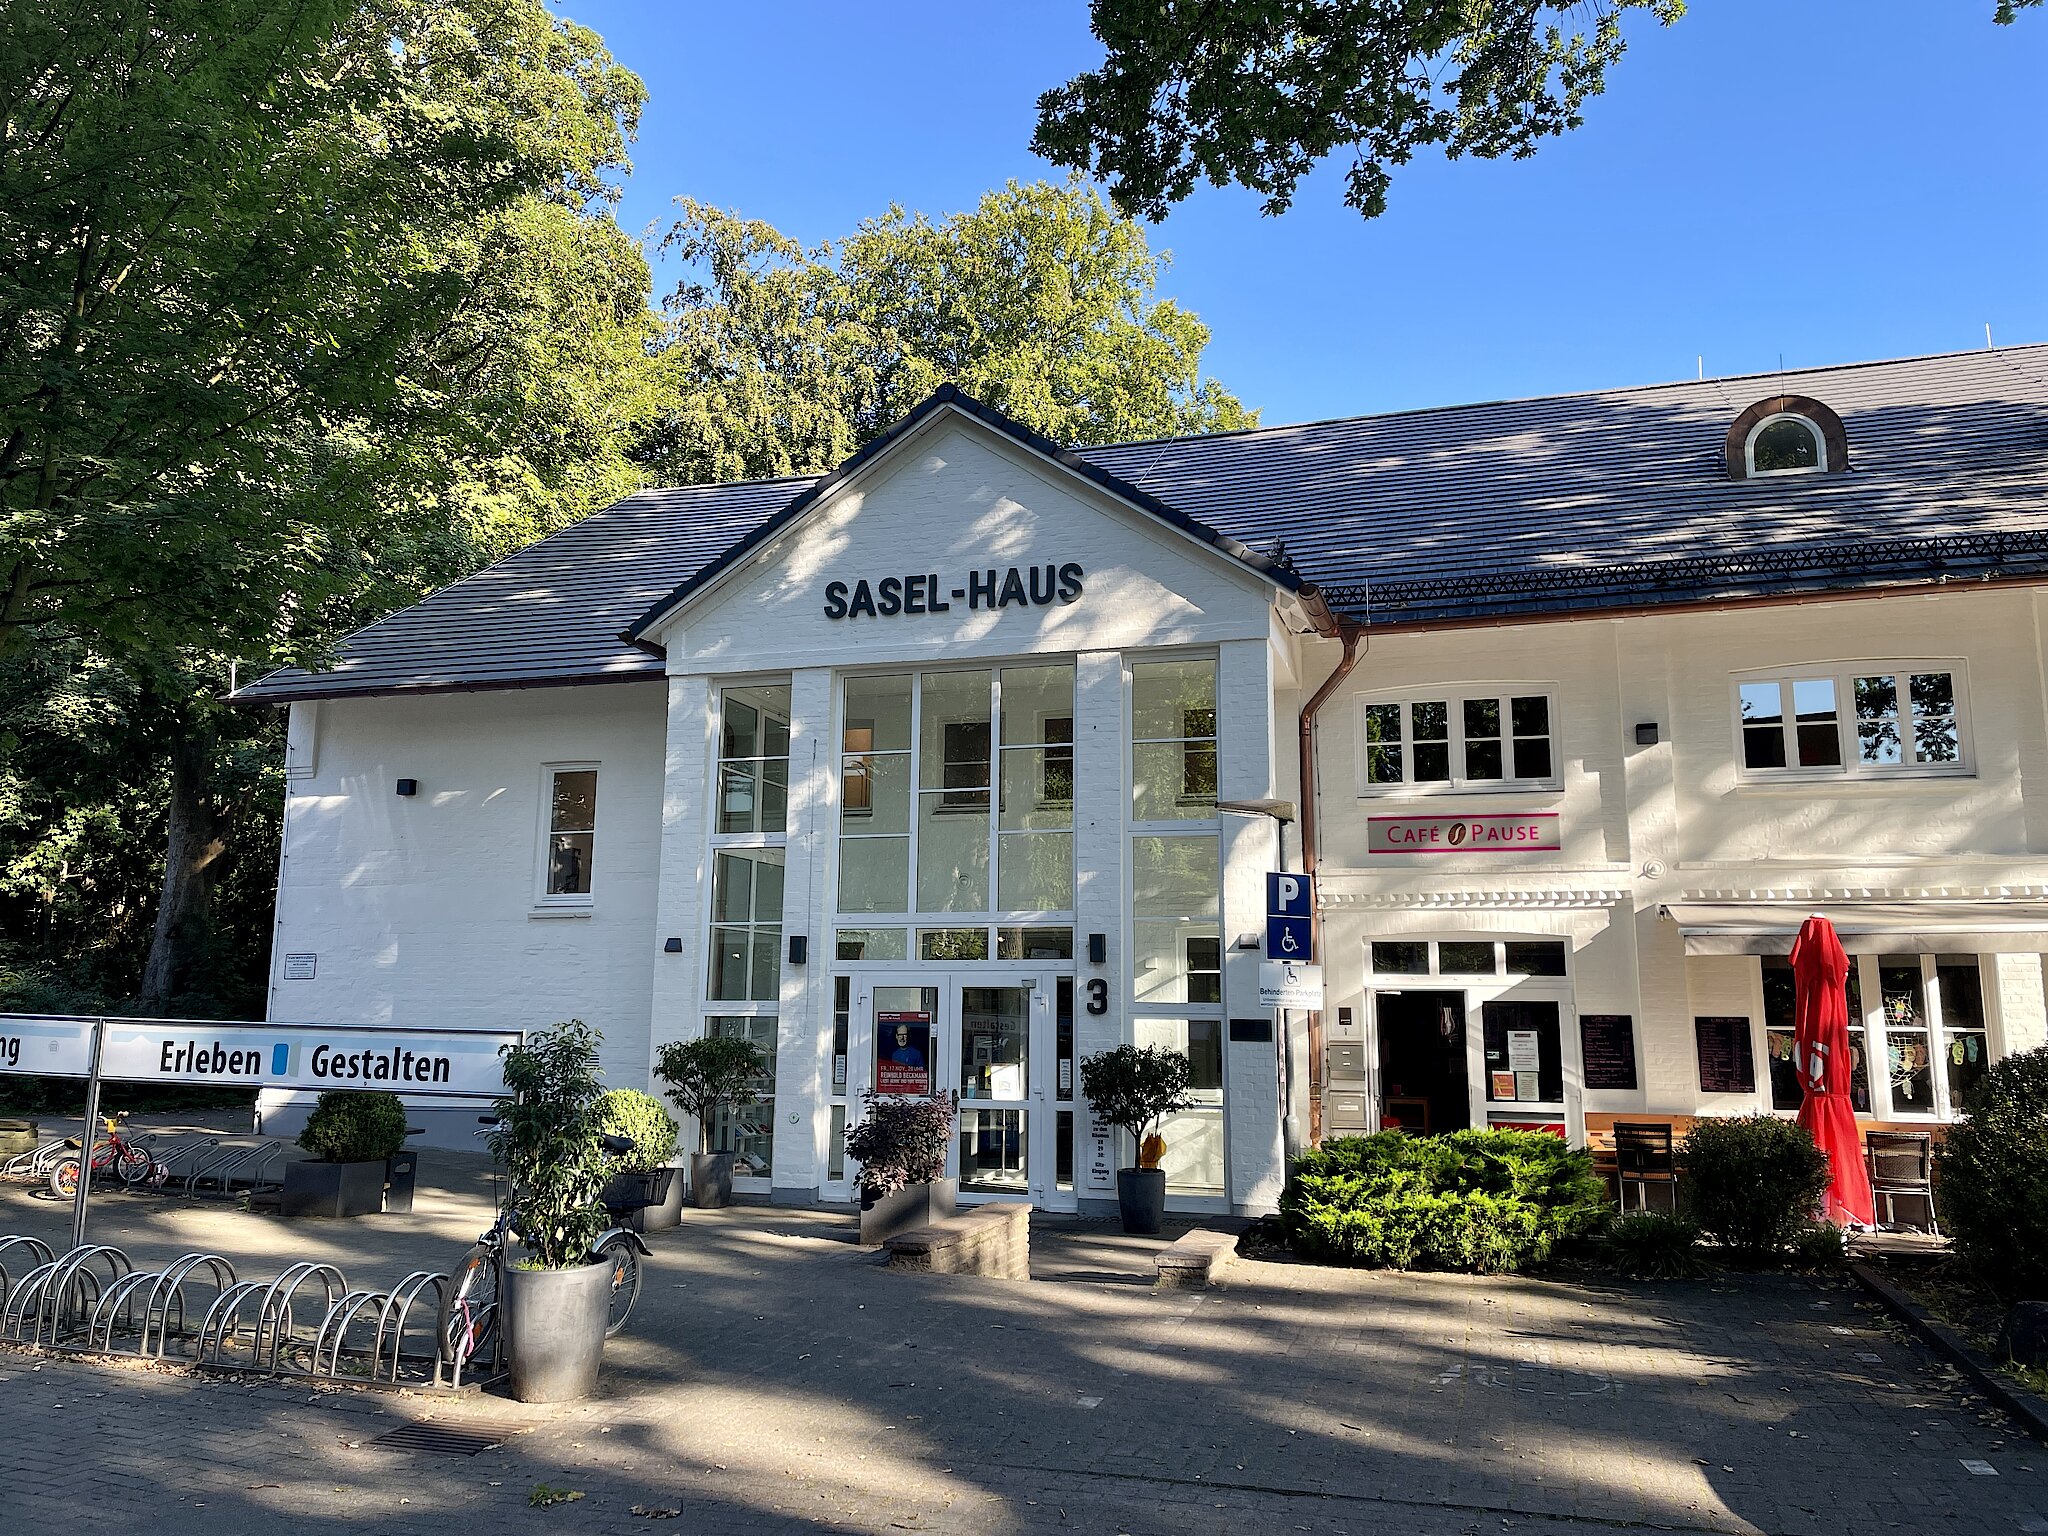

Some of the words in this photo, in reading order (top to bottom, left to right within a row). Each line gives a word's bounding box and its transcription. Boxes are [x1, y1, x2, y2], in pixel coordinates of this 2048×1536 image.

[824, 563, 1083, 619] SASEL-HAUS
[1472, 824, 1539, 842] PAUSE
[1278, 876, 1299, 911] P
[1087, 978, 1108, 1015] 3
[159, 1040, 261, 1075] Erleben
[311, 1044, 450, 1082] Gestalten
